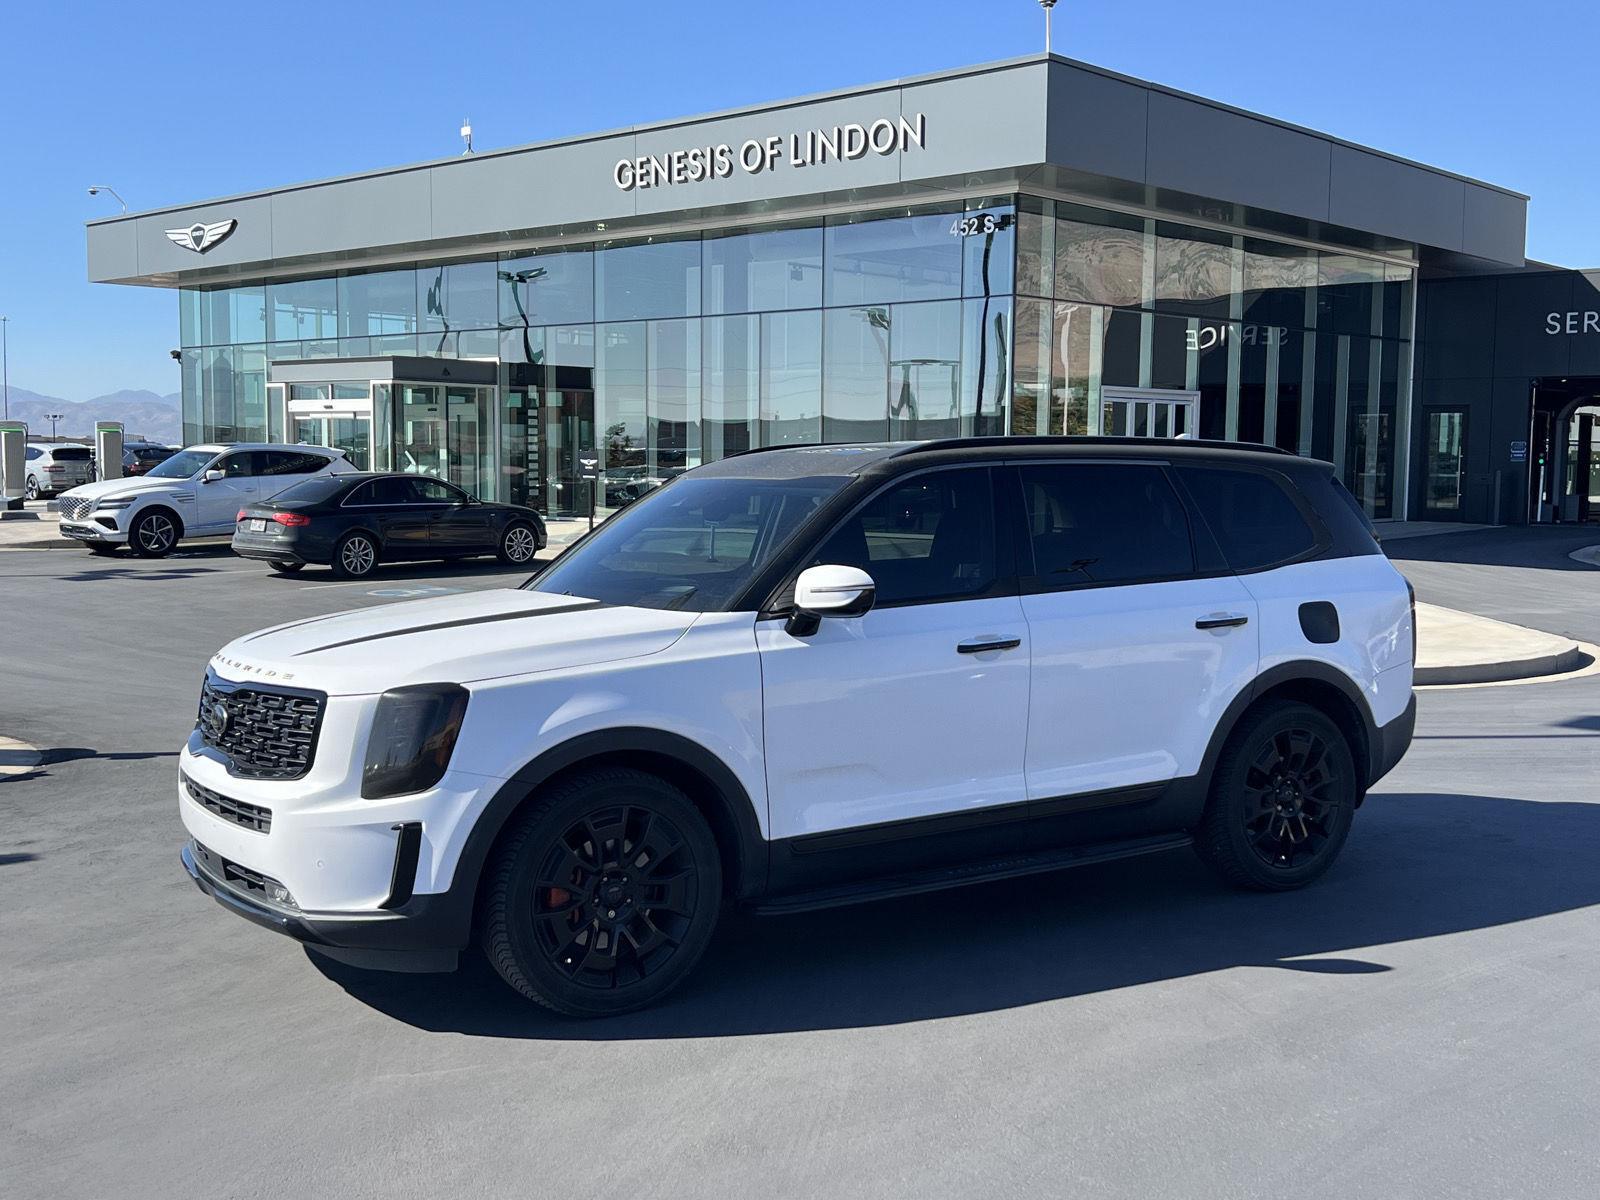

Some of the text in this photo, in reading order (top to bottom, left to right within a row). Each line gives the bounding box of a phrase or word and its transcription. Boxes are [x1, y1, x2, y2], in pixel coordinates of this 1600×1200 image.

[614, 113, 926, 190] GENESIS OF LINDON
[949, 217, 978, 237] 452
